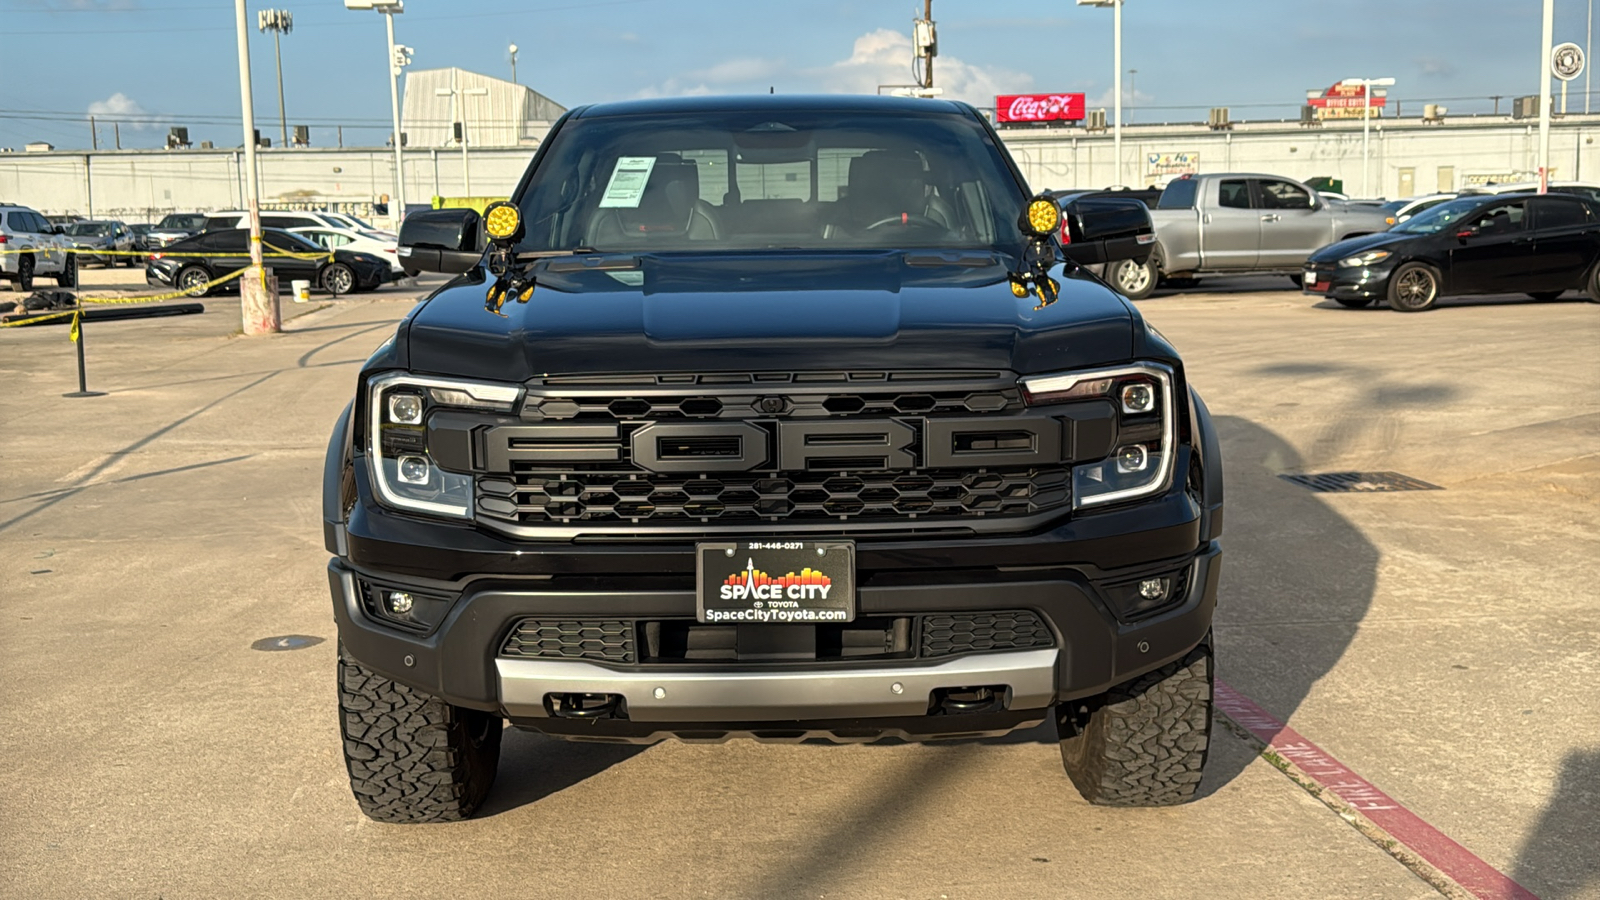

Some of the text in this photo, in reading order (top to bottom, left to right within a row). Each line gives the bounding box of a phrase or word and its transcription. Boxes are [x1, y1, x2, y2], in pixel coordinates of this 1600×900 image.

[484, 417, 1062, 475] FORD
[749, 542, 803, 550] 281-446-0271
[720, 584, 832, 600] SPACE CITY
[706, 609, 846, 621] SpaceCityToyota.com
[1275, 742, 1348, 775] LANE
[1327, 779, 1398, 810] FIRE
